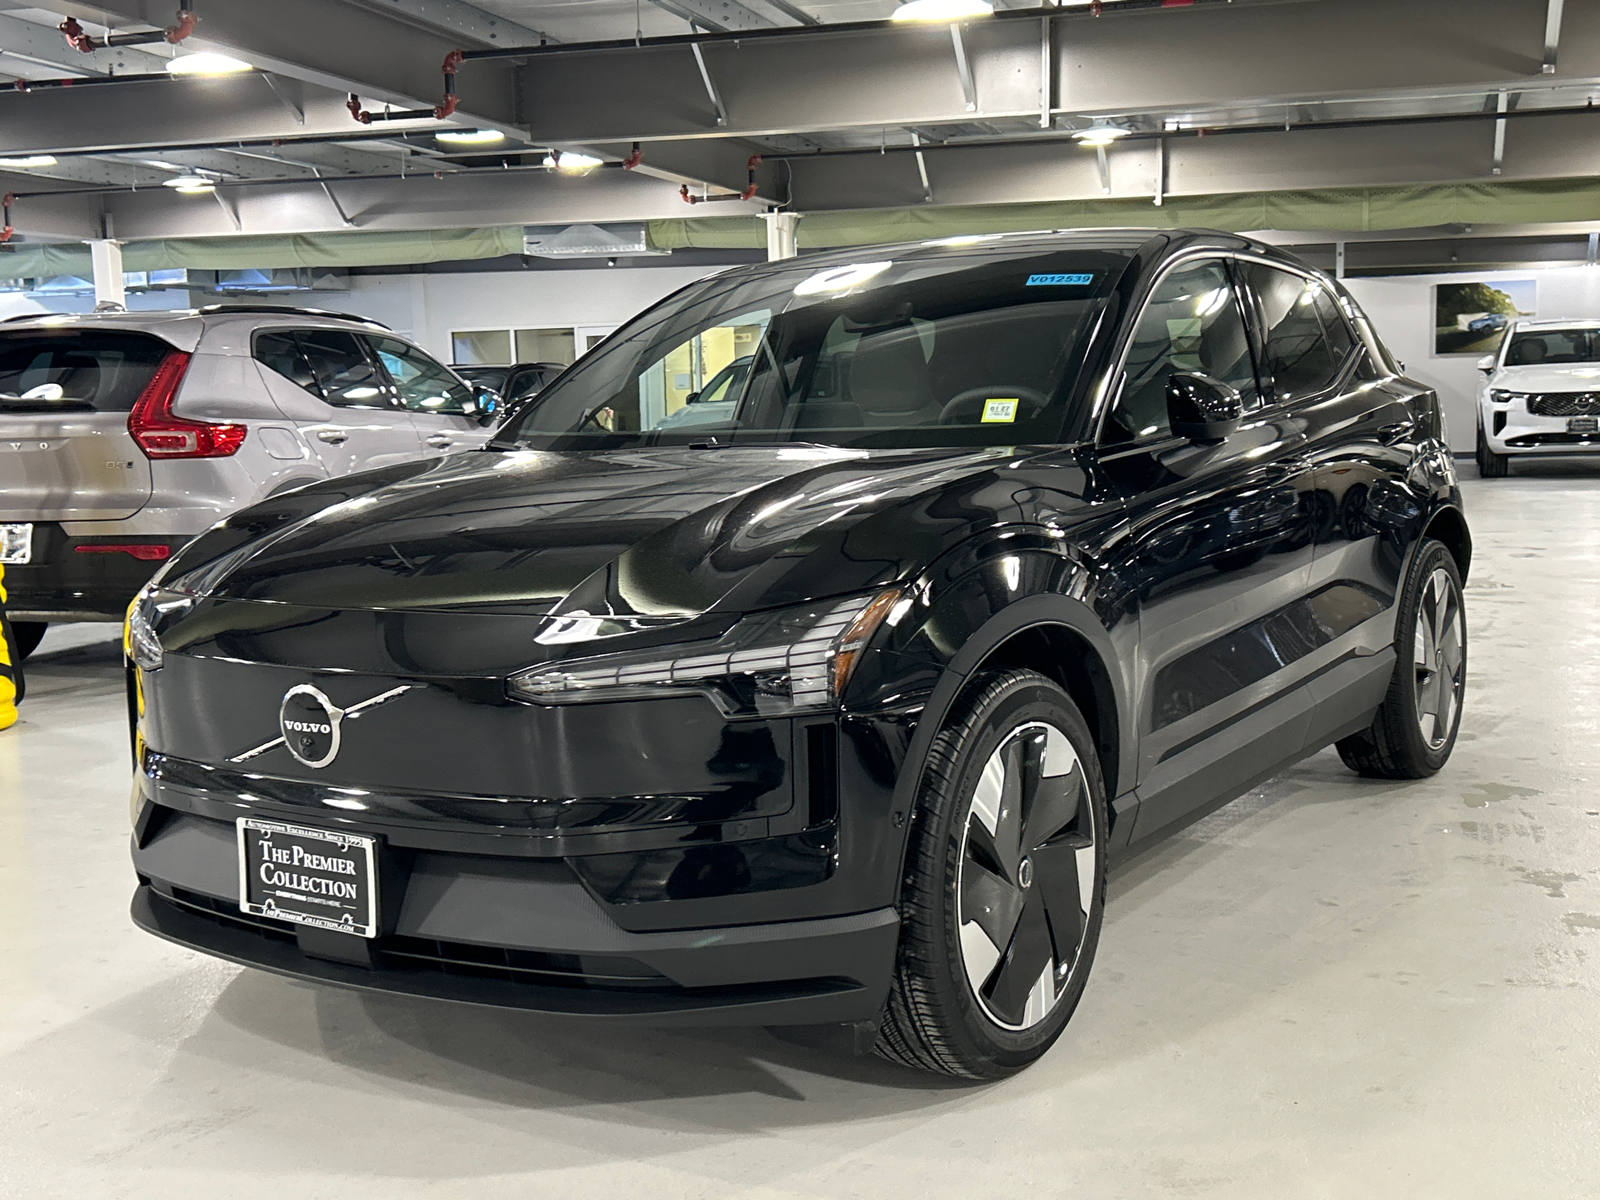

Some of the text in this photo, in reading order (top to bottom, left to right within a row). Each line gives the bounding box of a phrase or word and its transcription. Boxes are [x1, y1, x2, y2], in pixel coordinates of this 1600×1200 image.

[1030, 275, 1091, 283] V012539
[284, 720, 331, 734] VOLVO
[258, 840, 357, 876] THE PREMIER
[259, 862, 358, 899] COLLECTION
